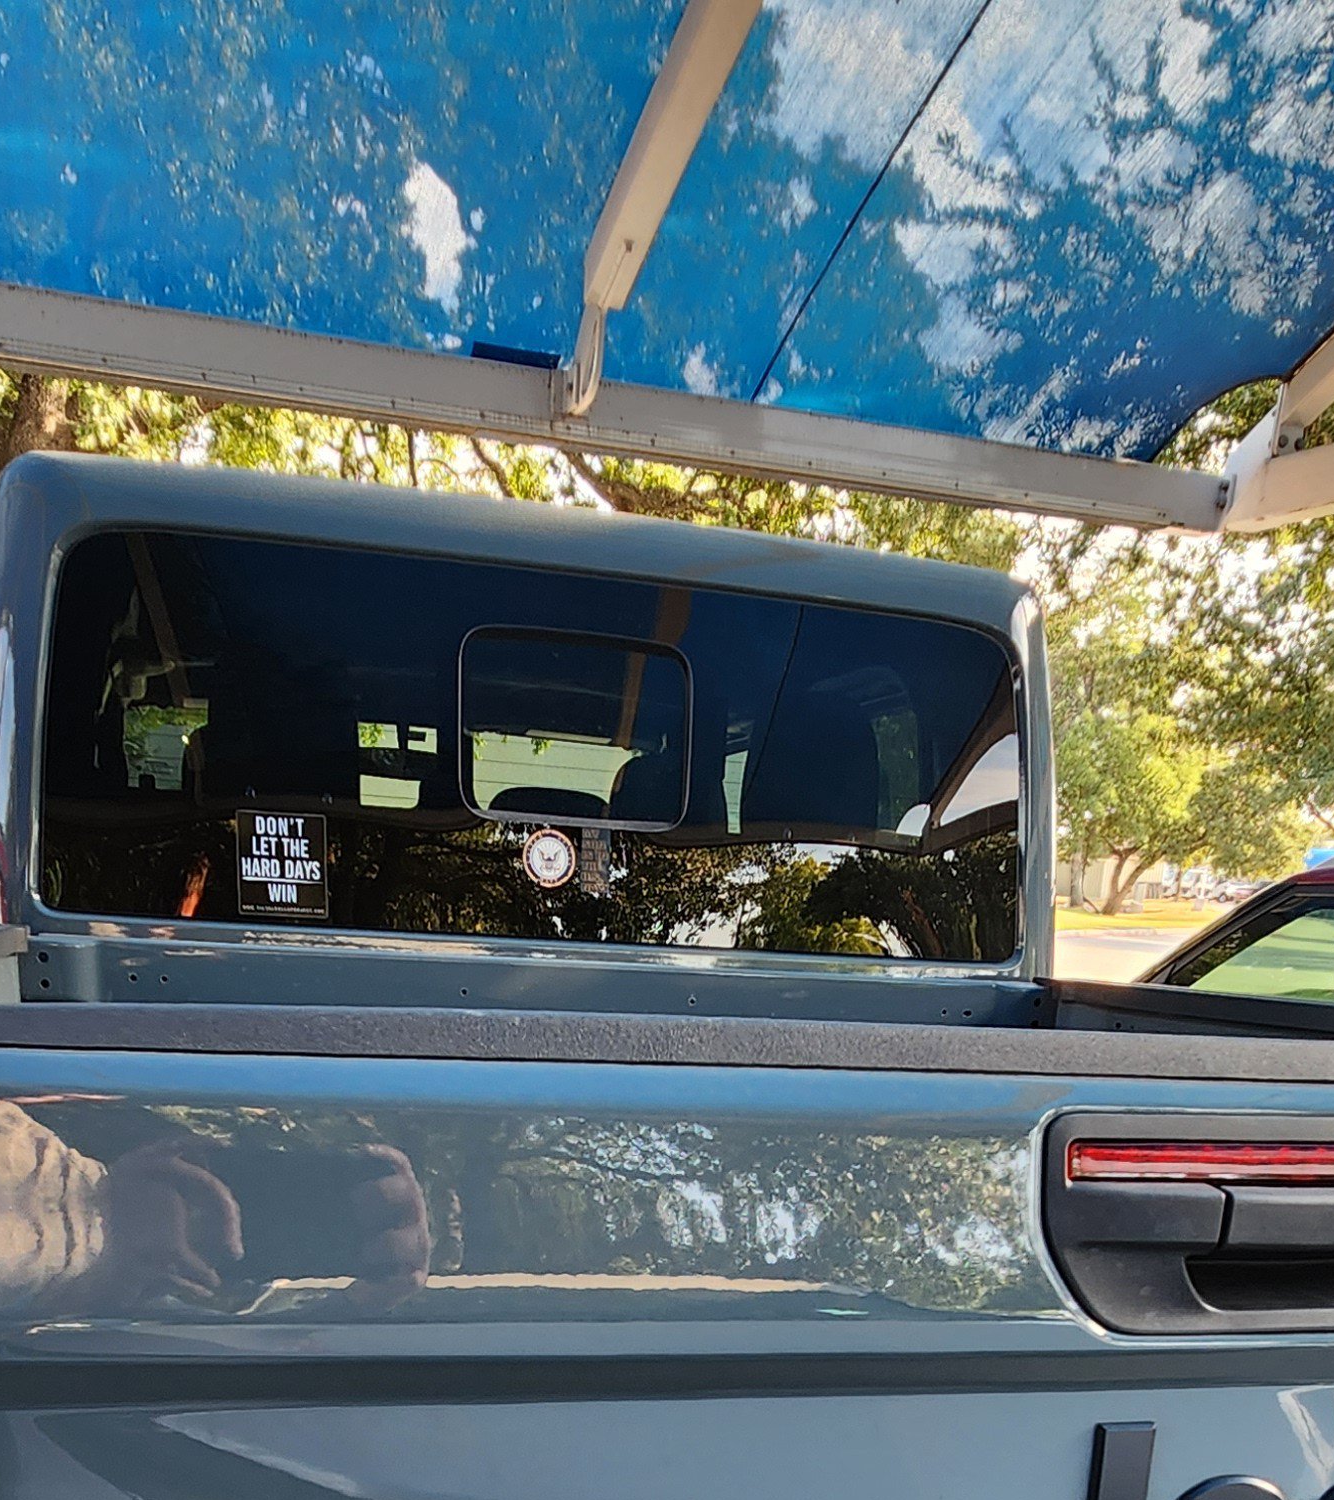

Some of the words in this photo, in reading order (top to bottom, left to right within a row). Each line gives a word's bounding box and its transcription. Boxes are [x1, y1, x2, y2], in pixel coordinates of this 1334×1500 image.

[255, 816, 304, 837] DON'T
[252, 835, 278, 856] LET
[281, 838, 310, 858] THE
[241, 856, 281, 878] HARD
[284, 859, 321, 880] DAYS
[267, 883, 297, 903] WIN
